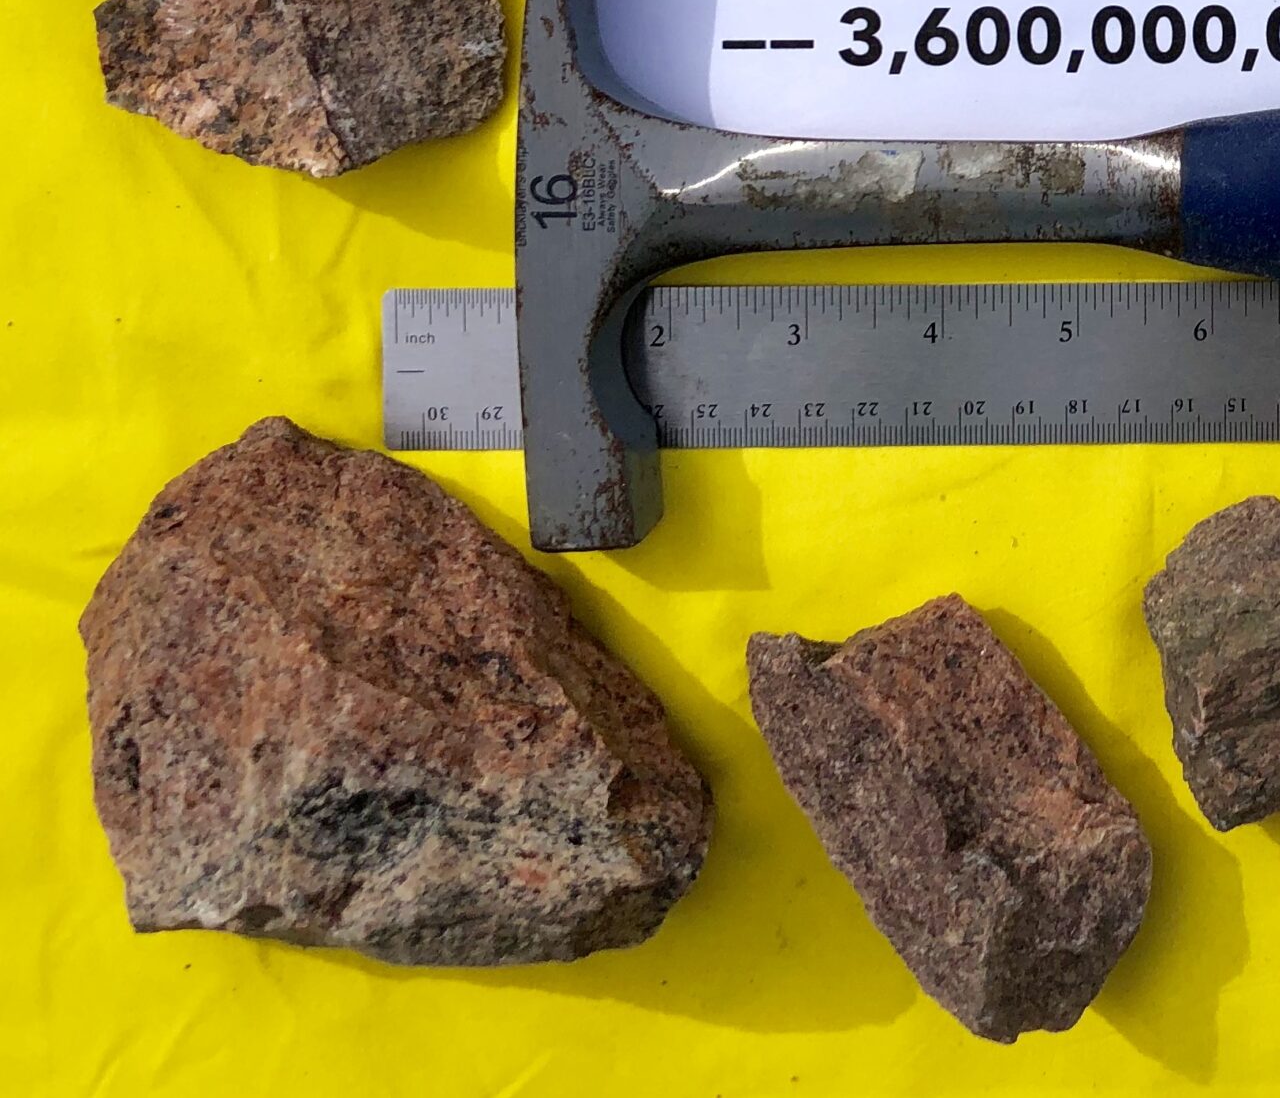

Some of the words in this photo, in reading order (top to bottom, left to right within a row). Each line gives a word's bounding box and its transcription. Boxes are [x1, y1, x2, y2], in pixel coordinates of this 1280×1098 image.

[530, 173, 578, 230] 16
[582, 157, 596, 232] E3-16BLC
[405, 332, 436, 345] inch
[650, 324, 665, 347] 2
[787, 324, 801, 346] 3
[923, 322, 938, 343] 4
[1059, 321, 1072, 342] 5
[1193, 319, 1207, 341] 6
[697, 404, 718, 419] 25
[750, 404, 772, 419] 24
[805, 403, 825, 418] 23
[857, 402, 879, 416] 22
[913, 402, 932, 416] 21
[964, 401, 985, 416] 20
[1016, 400, 1034, 415] 19
[1069, 400, 1087, 415] 18
[1122, 399, 1140, 414] 17
[1175, 398, 1193, 413] 16
[1228, 398, 1246, 413] 15
[428, 406, 449, 421] 30
[481, 406, 503, 421] 29
